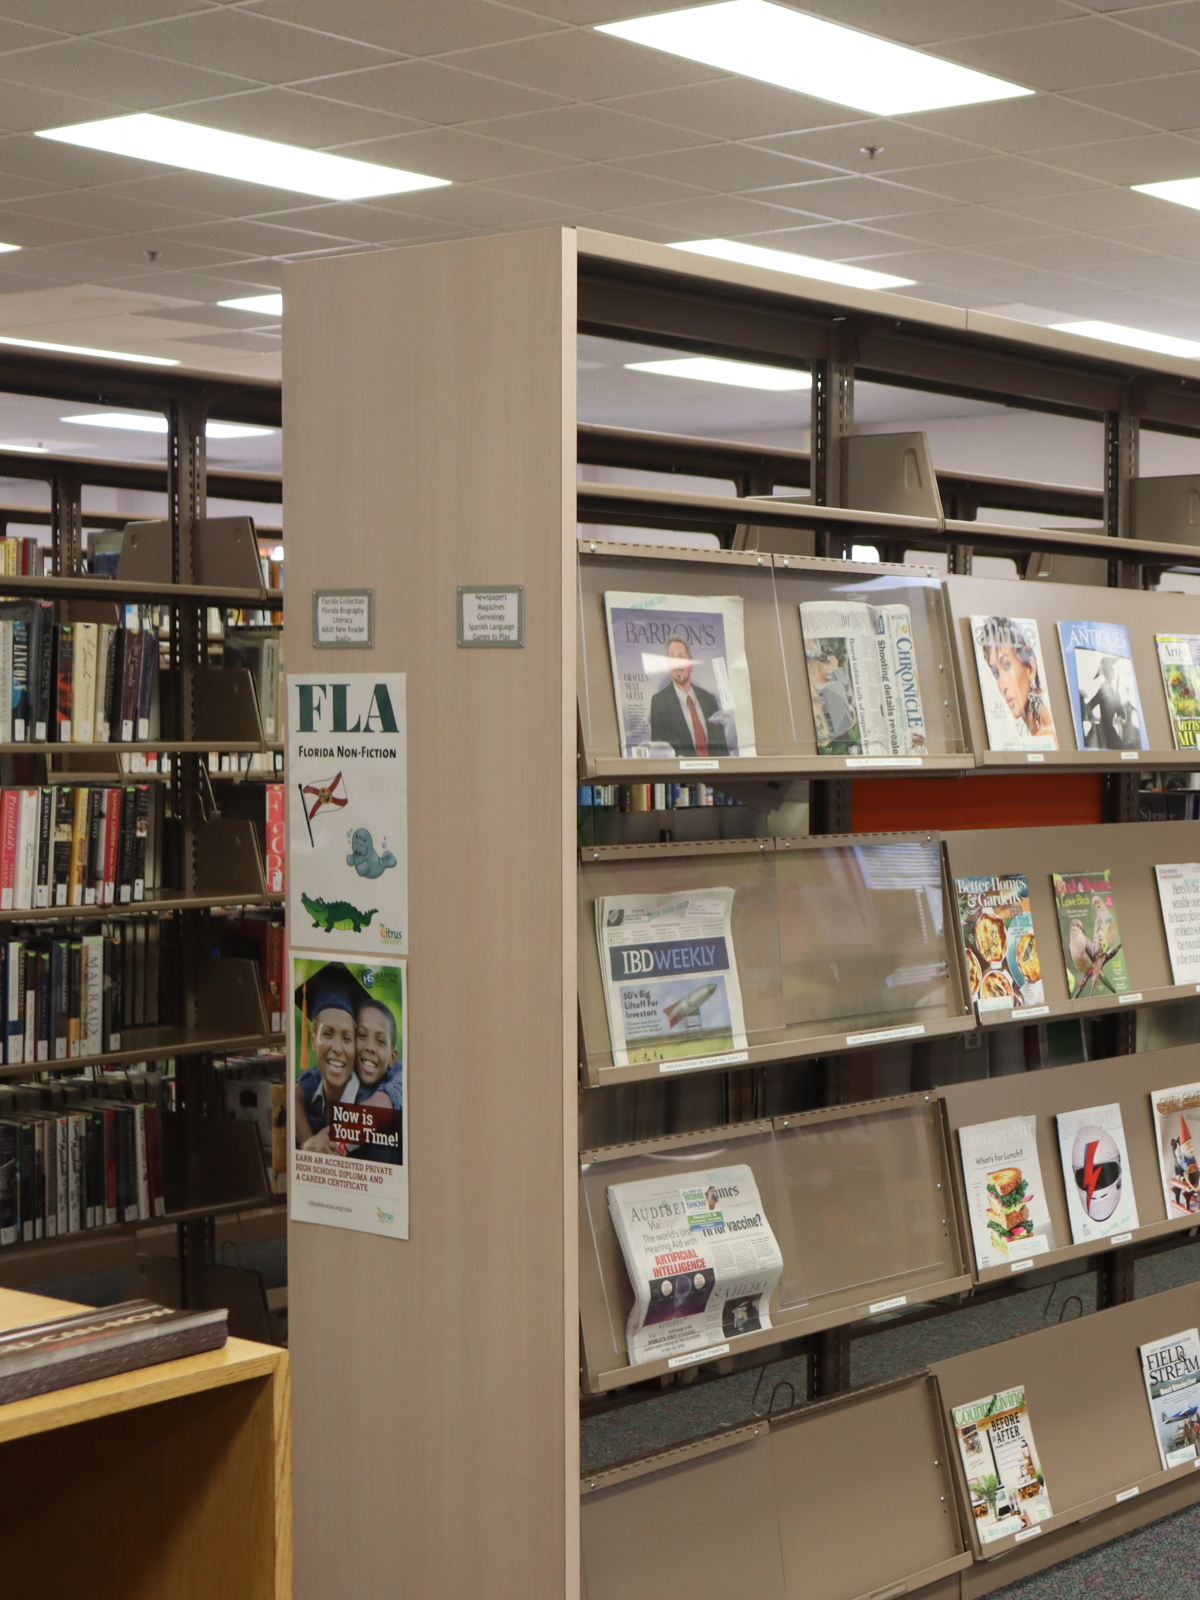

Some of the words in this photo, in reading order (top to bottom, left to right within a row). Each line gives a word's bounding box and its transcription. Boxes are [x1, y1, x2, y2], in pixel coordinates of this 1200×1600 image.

[475, 594, 507, 602] Newspapers
[468, 623, 488, 631] Spanish
[489, 623, 515, 631] Language
[477, 613, 505, 622] Genealogy
[1069, 629, 1126, 651] ANTIQUES
[14, 644, 28, 692] LINCOLN
[42, 634, 50, 698] LINCOLN
[878, 640, 890, 682] Shooting
[884, 684, 894, 720] details
[895, 637, 923, 727] CHRONICLE
[295, 683, 400, 733] FLA
[298, 745, 334, 757] FLORIDA
[337, 746, 396, 758] NON-FICTION
[6, 796, 18, 850] Priestdaddy
[958, 879, 990, 894] Better
[991, 877, 1026, 892] Homes
[968, 894, 978, 908] &
[978, 891, 1021, 906] Gardens
[380, 927, 402, 939] Citrus
[622, 949, 654, 974] IBD
[654, 946, 715, 970] WEEKLY
[88, 956, 98, 1034] MALRAUX
[624, 992, 638, 1000] 5G's
[639, 990, 650, 1000] Big
[624, 1000, 646, 1009] Liftoff
[626, 1010, 657, 1018] Investors
[333, 1105, 360, 1123] Now
[362, 1109, 373, 1126] is
[333, 1123, 360, 1144] Your
[363, 1127, 398, 1147] Time!
[988, 1122, 1033, 1147] appétit
[296, 1153, 313, 1162] EARN
[314, 1156, 324, 1164] AN
[324, 1158, 364, 1171] ACCREDITED
[365, 1164, 393, 1176] PRIVATE
[976, 1154, 994, 1165] What's
[1004, 1149, 1023, 1160] Lunch?
[296, 1163, 311, 1172] HIGH
[312, 1166, 338, 1176] SCHOOL
[339, 1170, 367, 1182] DIPLOMA
[370, 1175, 384, 1184] AND
[302, 1174, 326, 1184] CAREER
[328, 1178, 368, 1192] CERTIFICATE
[684, 1192, 704, 1202] HOME
[686, 1200, 706, 1209] SHOW
[726, 1213, 762, 1232] vaccine?
[642, 1234, 655, 1243] The
[656, 1230, 680, 1242] world's
[644, 1243, 672, 1254] Hearing
[672, 1240, 683, 1249] Aid
[684, 1237, 698, 1247] with
[654, 1248, 698, 1266] ARTIFICIAL
[652, 1258, 706, 1278] INTELLIGENCE
[1146, 1345, 1185, 1370] FIELD
[1150, 1355, 1200, 1386] STREAM
[1172, 1381, 1188, 1392] Stories
[954, 1400, 995, 1426] Country
[994, 1388, 1026, 1412] Living
[991, 1412, 1020, 1432] BEFORE
[996, 1426, 1020, 1444] AFTER
